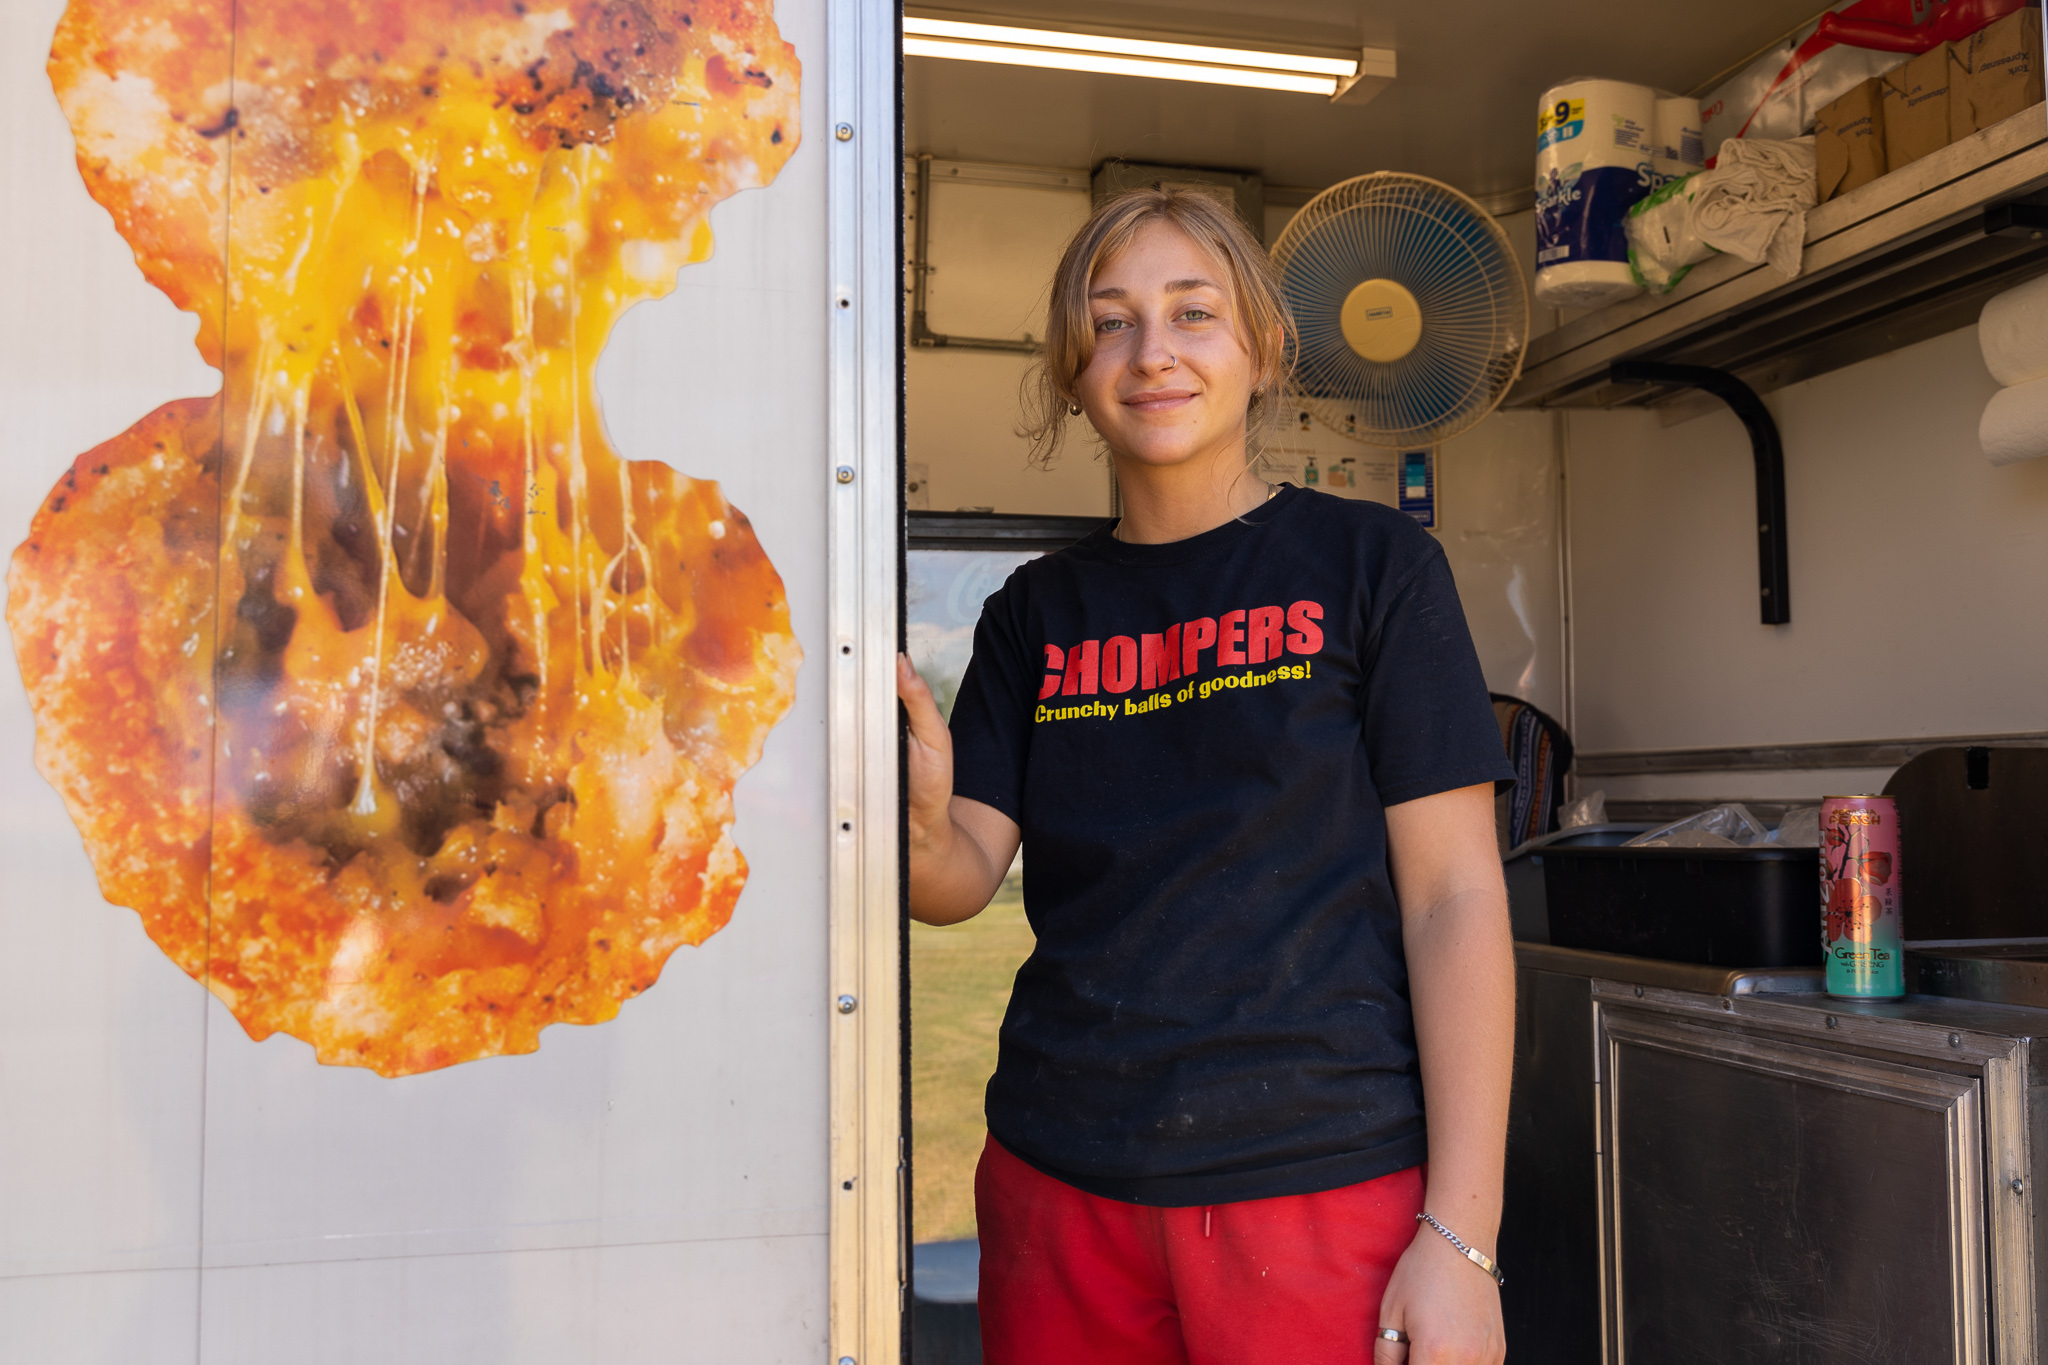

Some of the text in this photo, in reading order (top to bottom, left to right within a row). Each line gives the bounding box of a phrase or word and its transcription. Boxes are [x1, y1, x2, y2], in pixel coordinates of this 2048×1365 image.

[1979, 52, 2030, 72] Xpressnap
[2008, 64, 2031, 76] Tork
[1555, 101, 1570, 125] 9
[1038, 600, 1324, 700] CHOMPERS
[1035, 660, 1312, 723] Crunchy balls of goodness!
[1828, 815, 1881, 826] PEACH
[1834, 947, 1890, 960] Green Tea
